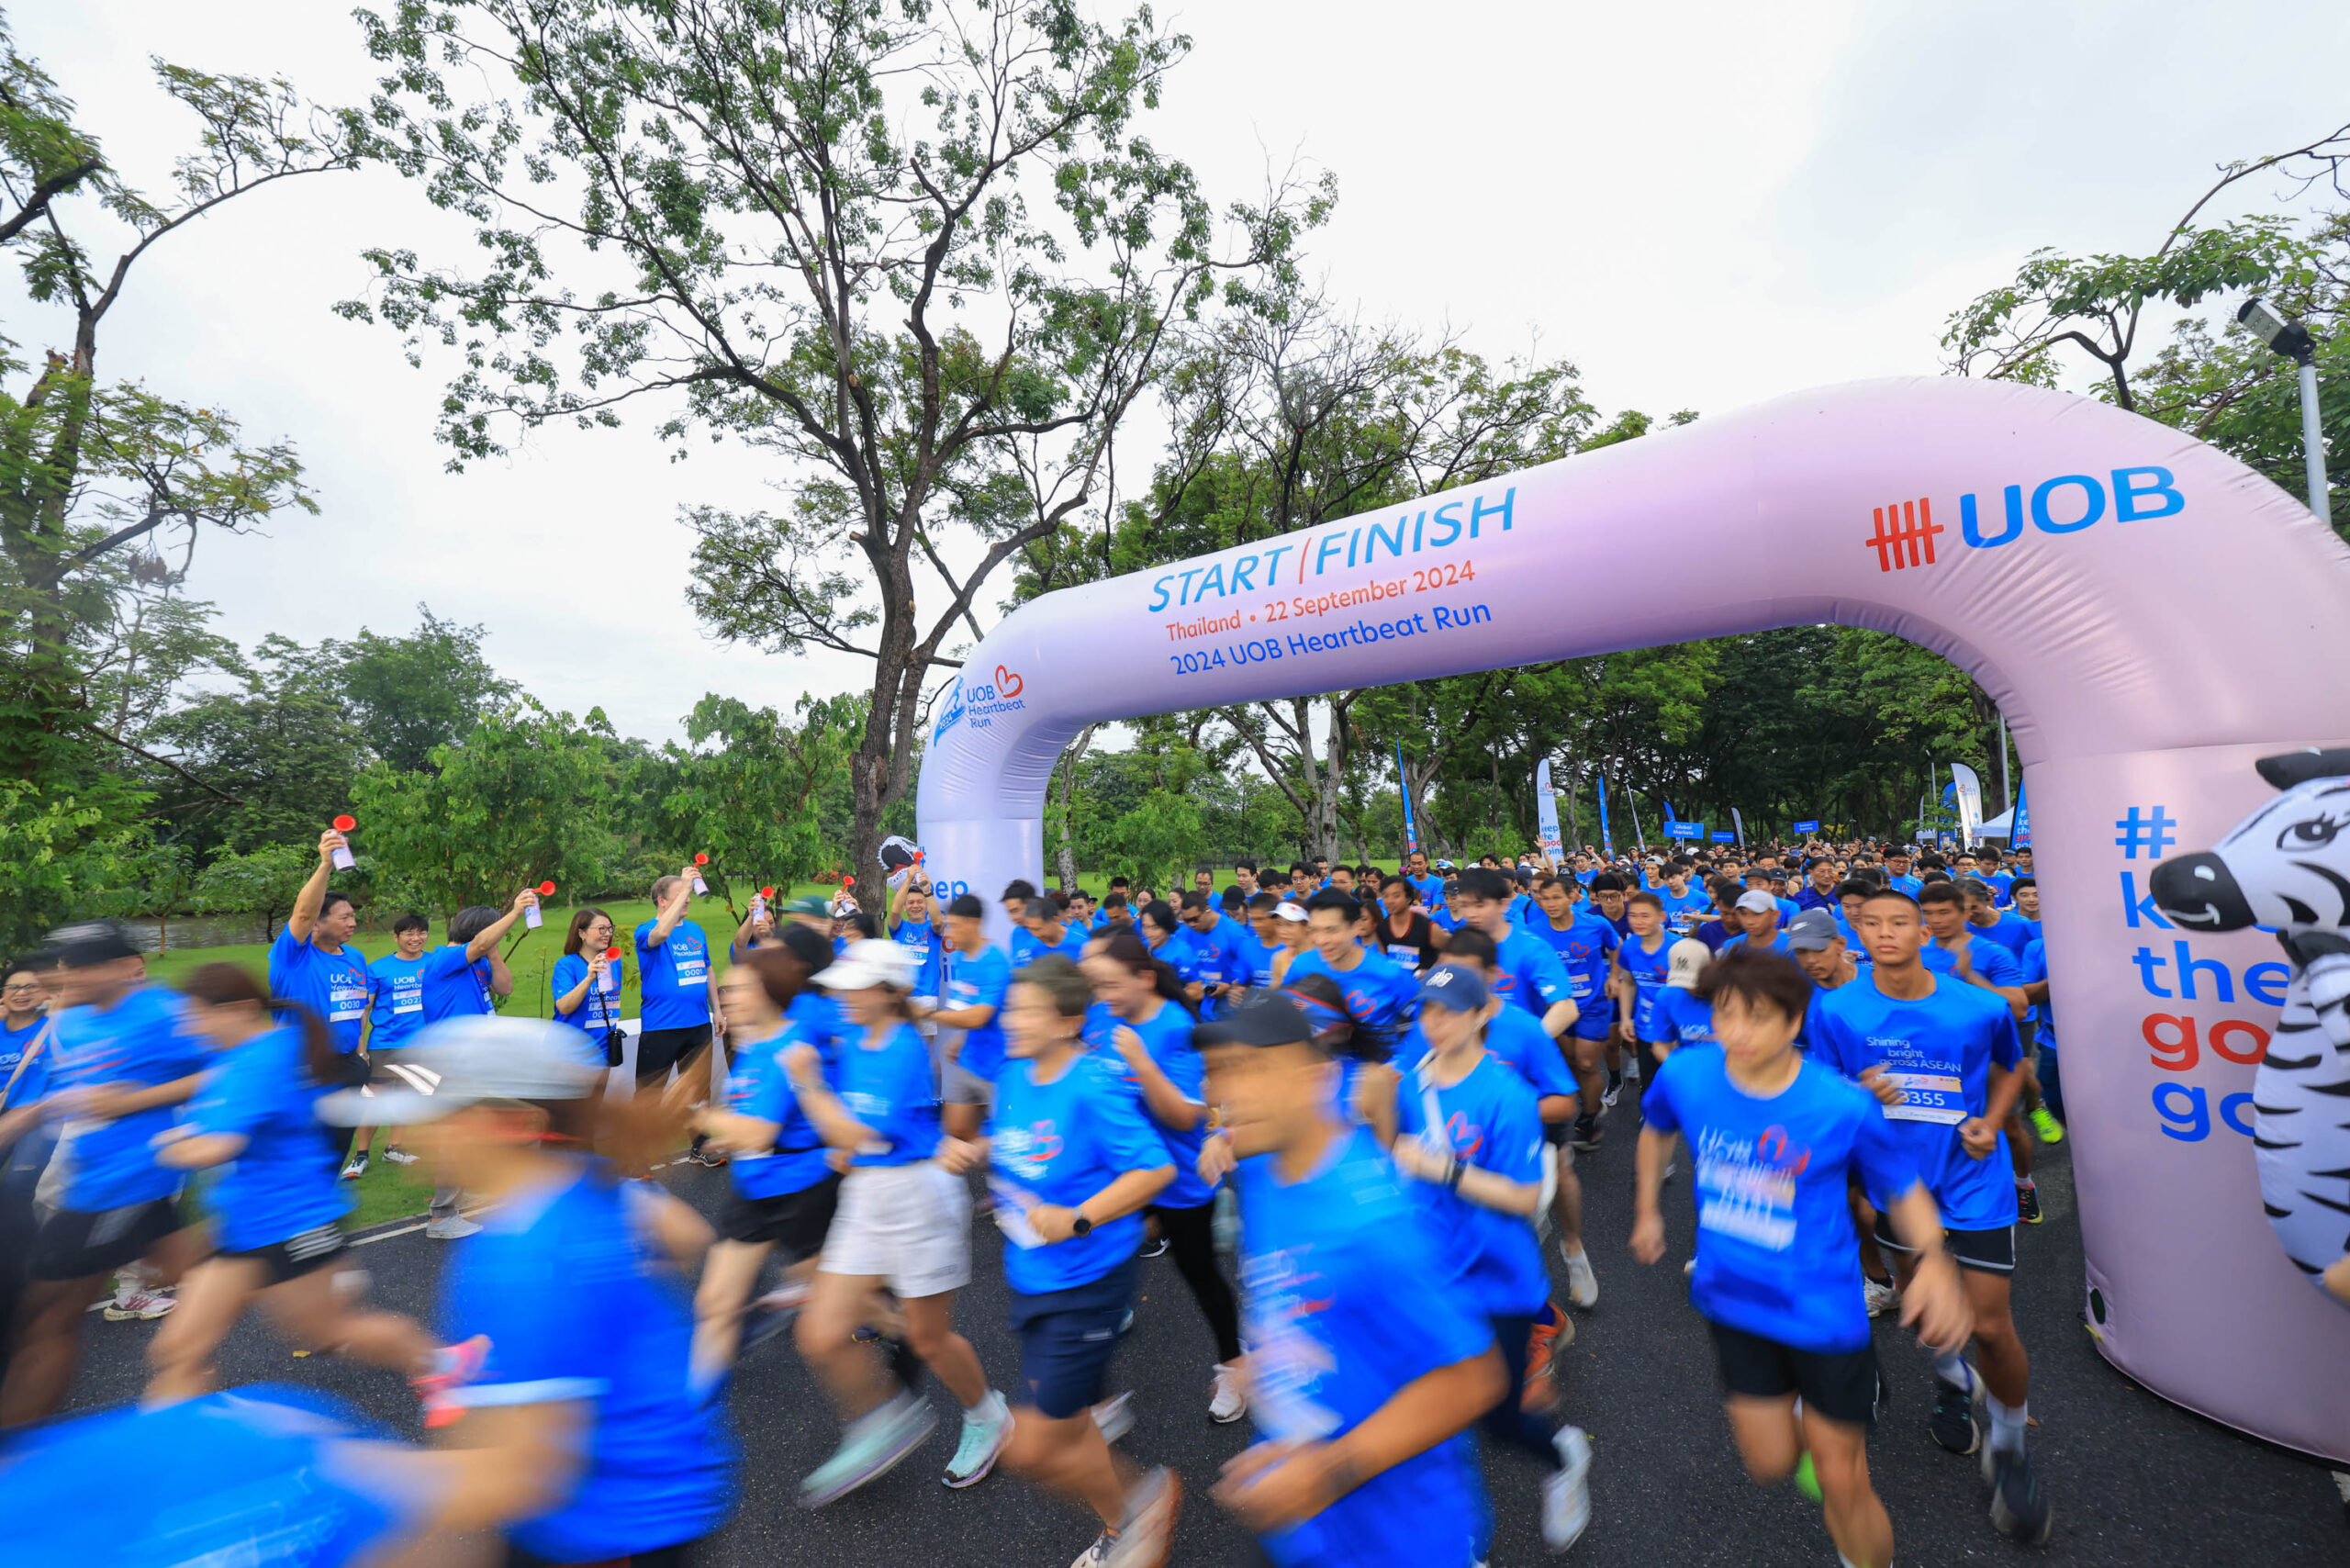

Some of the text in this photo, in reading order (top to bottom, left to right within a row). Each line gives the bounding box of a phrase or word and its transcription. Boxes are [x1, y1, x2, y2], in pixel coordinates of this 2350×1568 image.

[1959, 465, 2186, 549] UOB
[1147, 544, 1294, 613] START
[1315, 487, 1516, 576] FINISH
[1166, 559, 1476, 642] Thailand 22 September 2024
[1169, 603, 1492, 676] 2024 UOB Heartbeat Run
[967, 685, 996, 703] UOB
[968, 699, 1026, 717] Heartbeat
[970, 717, 991, 729] Run
[393, 976, 416, 985] UOB
[2132, 939, 2290, 1007] the
[340, 1000, 361, 1011] 0030
[592, 1010, 613, 1019] 002
[1866, 1036, 1910, 1048] Shining
[2141, 1012, 2272, 1072] go
[0, 1052, 21, 1065] OB
[1887, 1047, 1925, 1059] bright
[1878, 1058, 1962, 1073] across ASEAN
